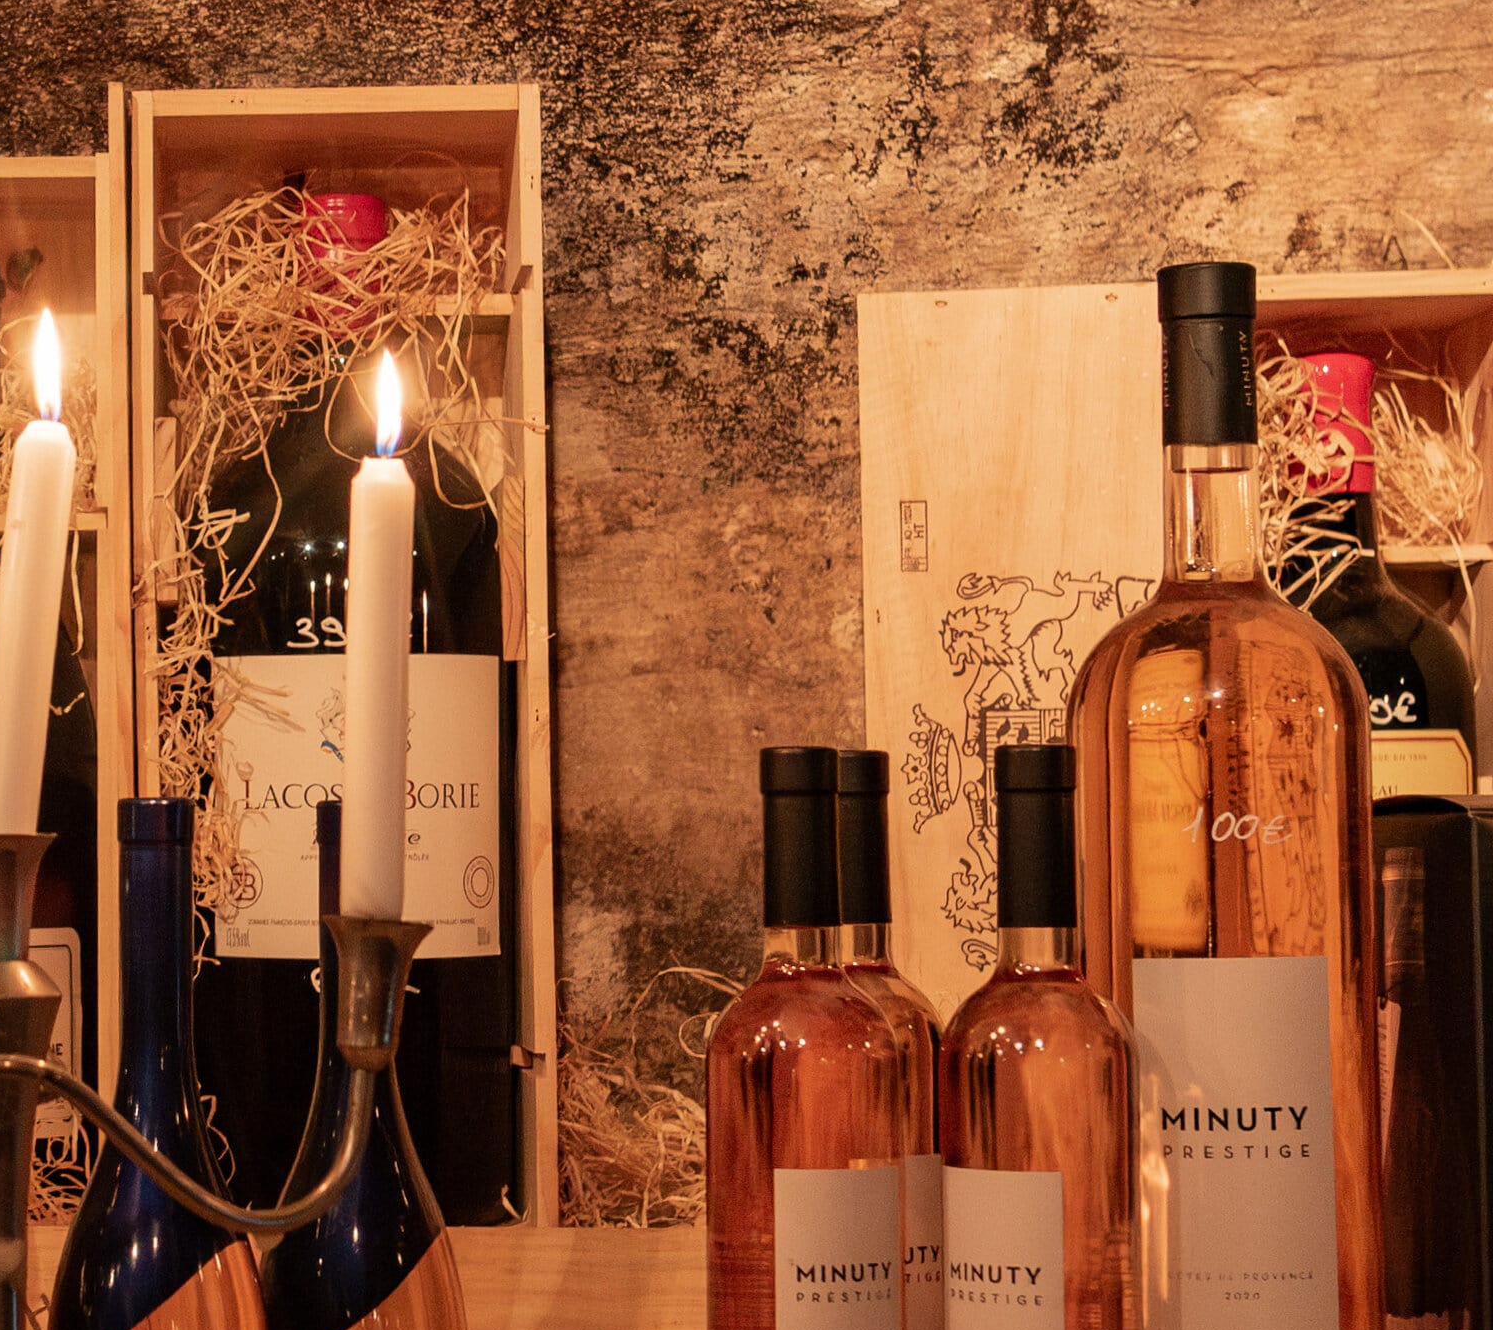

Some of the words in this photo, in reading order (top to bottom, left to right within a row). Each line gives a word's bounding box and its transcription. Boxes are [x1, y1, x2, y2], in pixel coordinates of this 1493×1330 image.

[1181, 809, 1295, 847] 100€
[1160, 1105, 1310, 1134] MINUTY
[1162, 1143, 1312, 1161] PRESTIGE
[795, 1261, 893, 1284] MINUTY
[949, 1262, 1043, 1286] MINUTY
[795, 1287, 893, 1304] PRESTIGE
[949, 1287, 1044, 1307] PRESTIGE
